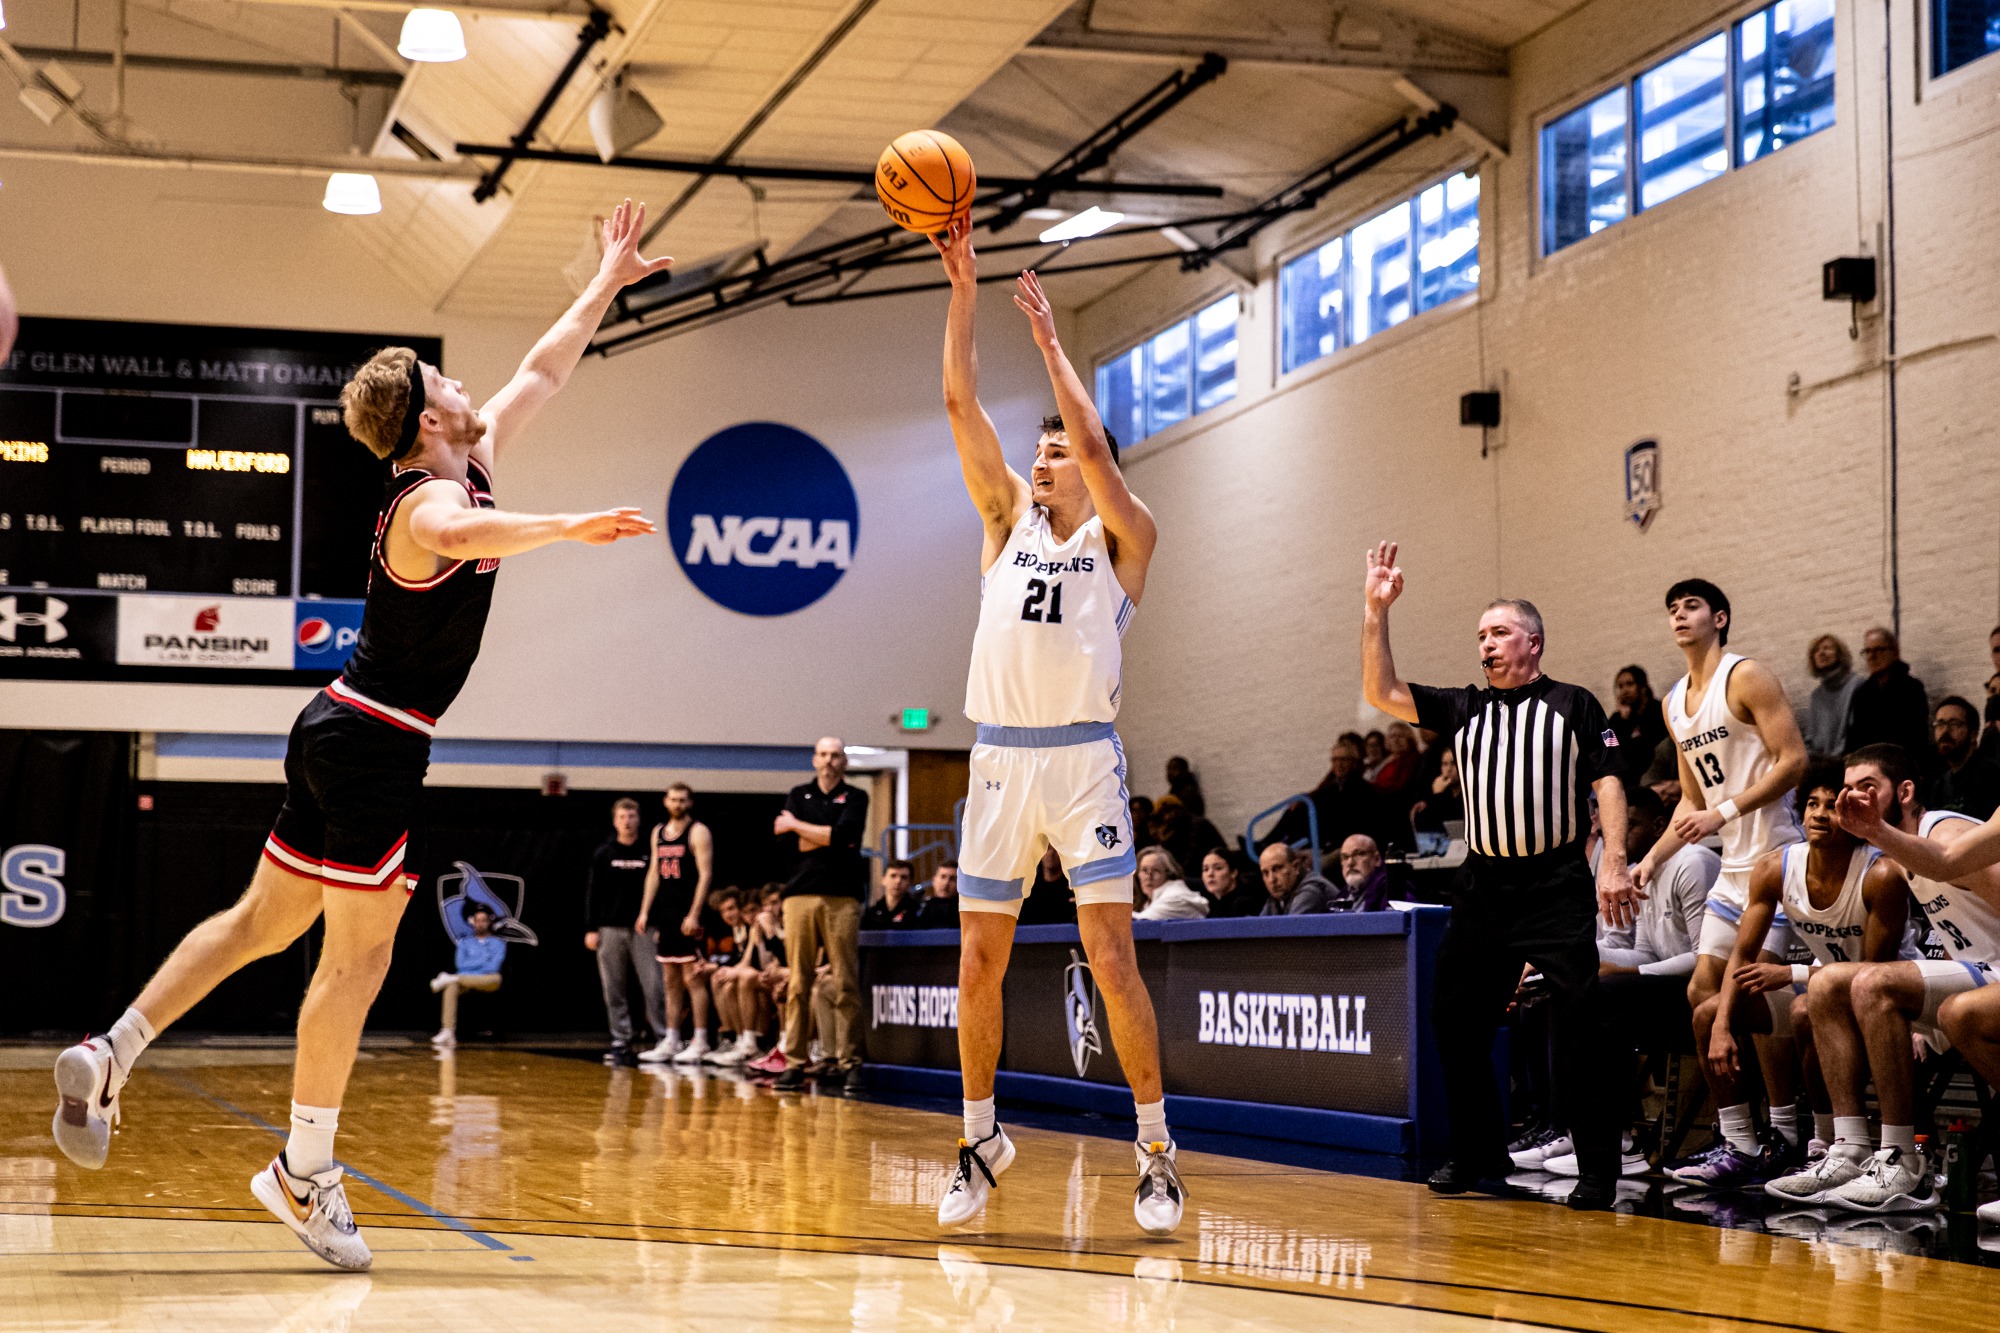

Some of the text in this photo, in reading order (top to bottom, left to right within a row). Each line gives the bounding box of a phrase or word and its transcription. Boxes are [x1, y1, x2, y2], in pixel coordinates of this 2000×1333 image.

[31, 352, 96, 374] GLEN
[102, 355, 171, 378] WALL
[176, 359, 194, 379] &
[200, 360, 269, 384] MATT
[100, 456, 151, 475] PERIOD
[80, 516, 172, 537] PLAYER FOUL
[235, 523, 281, 541] FOULS
[685, 513, 850, 570] NCAA
[1013, 551, 1095, 576] HOPKINS
[97, 572, 147, 590] MATCH
[232, 578, 278, 596] SCORE
[1021, 578, 1063, 624] 21
[144, 634, 270, 652] PANSINI
[1679, 726, 1729, 752] OPKINS
[1695, 753, 1725, 788] 13
[872, 985, 959, 1030] JOHNS HOPK
[1199, 991, 1371, 1055] BASKETBALL
